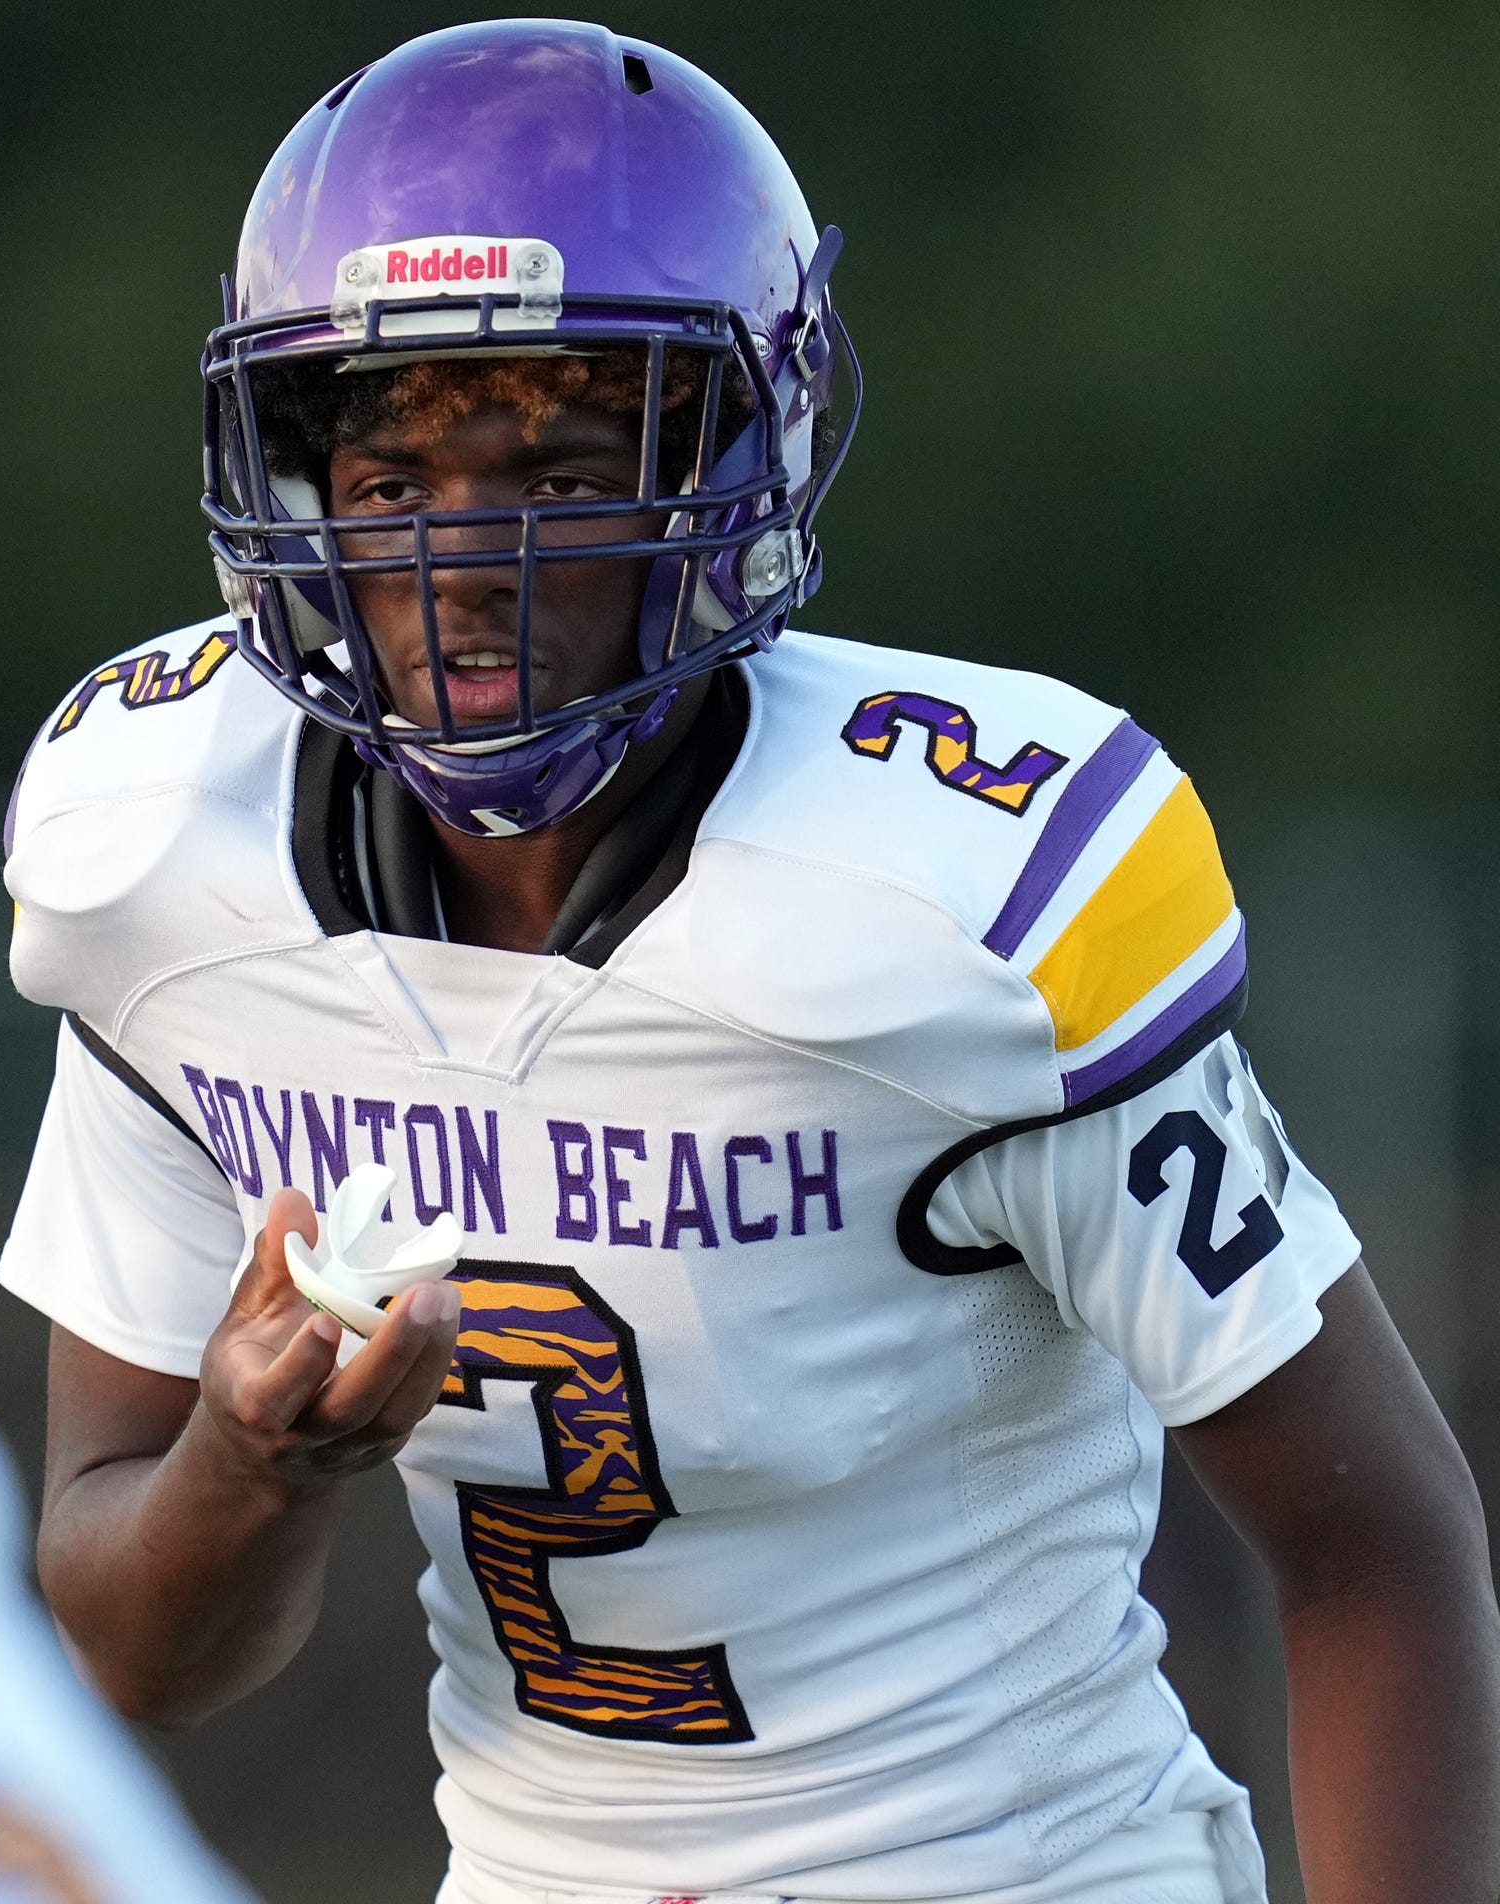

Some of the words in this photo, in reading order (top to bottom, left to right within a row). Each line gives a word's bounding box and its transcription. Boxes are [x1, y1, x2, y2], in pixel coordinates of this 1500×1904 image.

[386, 245, 508, 283] Riddell
[47, 630, 238, 743] 2
[840, 690, 1070, 818] 2
[179, 1062, 506, 1235] BOYNTON
[545, 1118, 845, 1251] BEACH
[376, 1257, 756, 1745] 2
